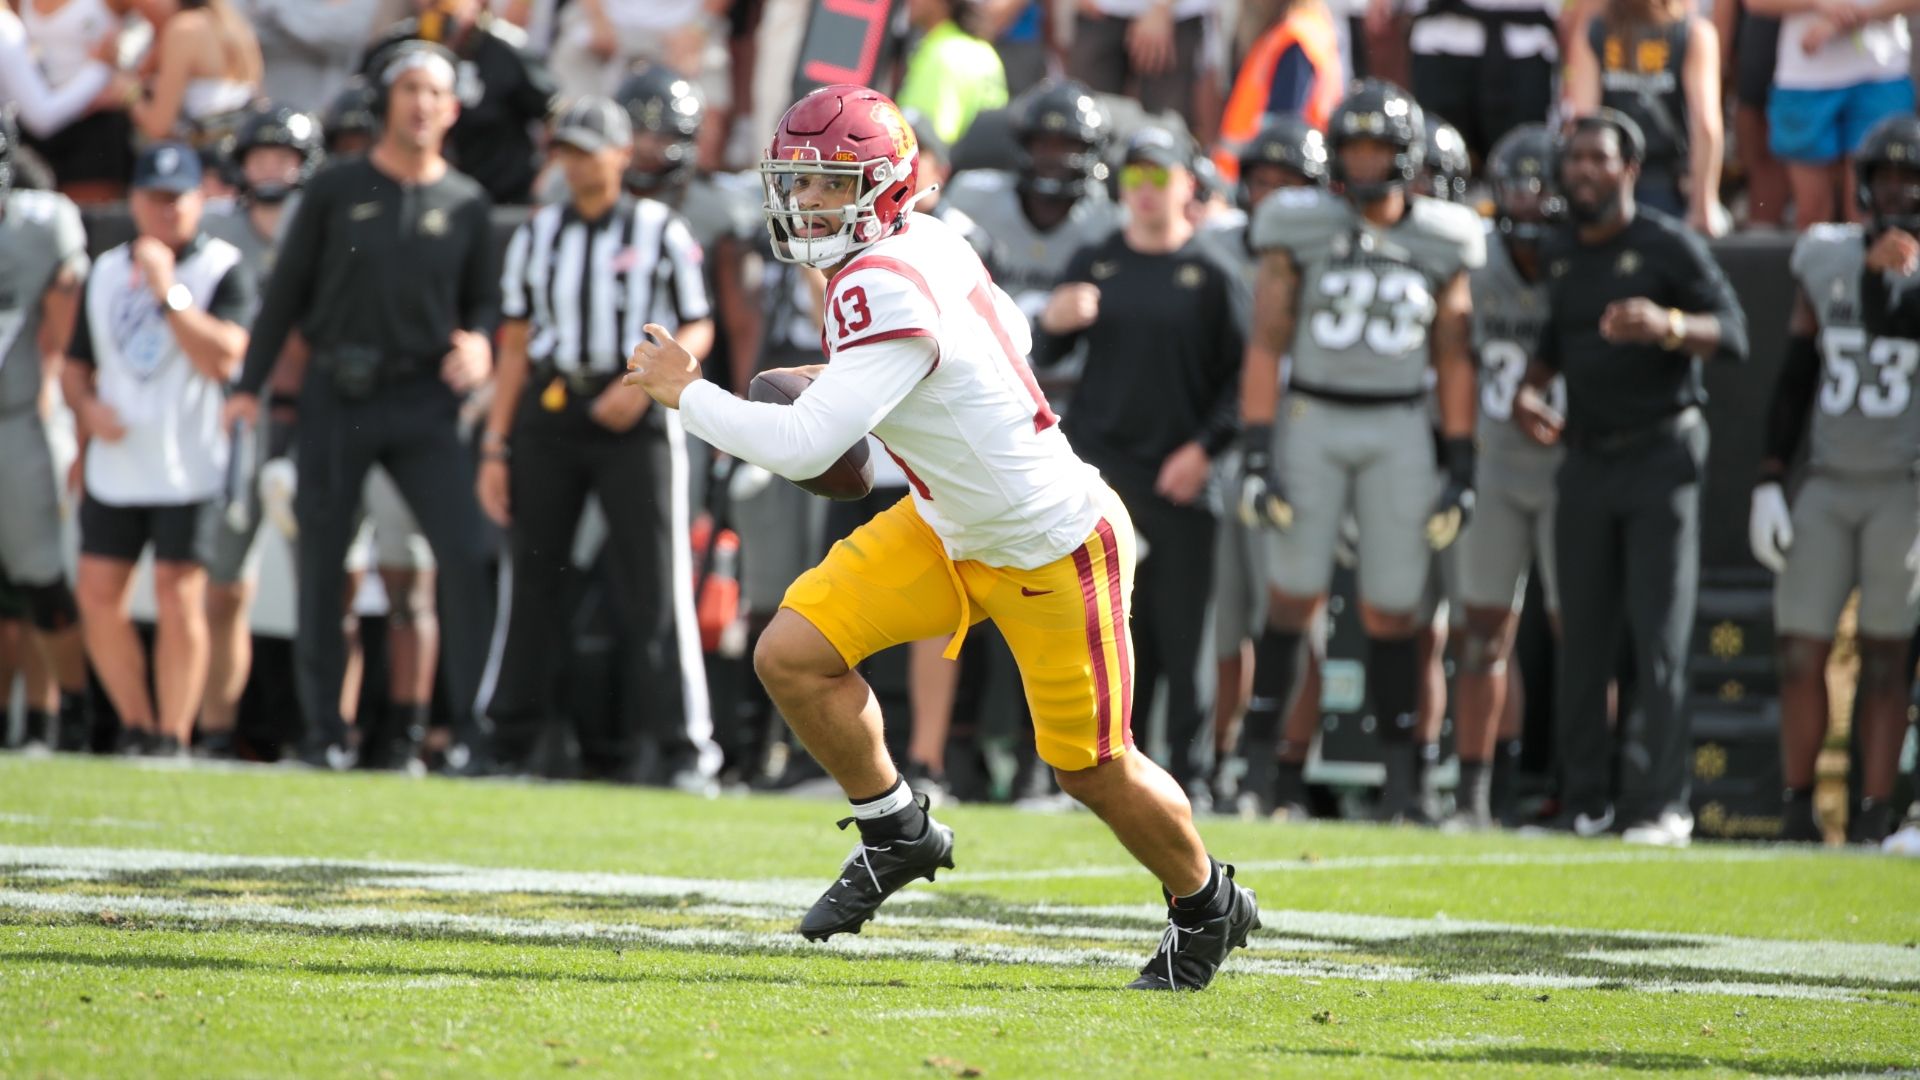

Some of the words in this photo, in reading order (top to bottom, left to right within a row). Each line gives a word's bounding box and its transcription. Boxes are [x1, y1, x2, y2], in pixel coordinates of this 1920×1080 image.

[836, 153, 854, 161] USC
[833, 286, 872, 339] 13
[1311, 269, 1437, 356] 33
[1820, 327, 1919, 418] 53
